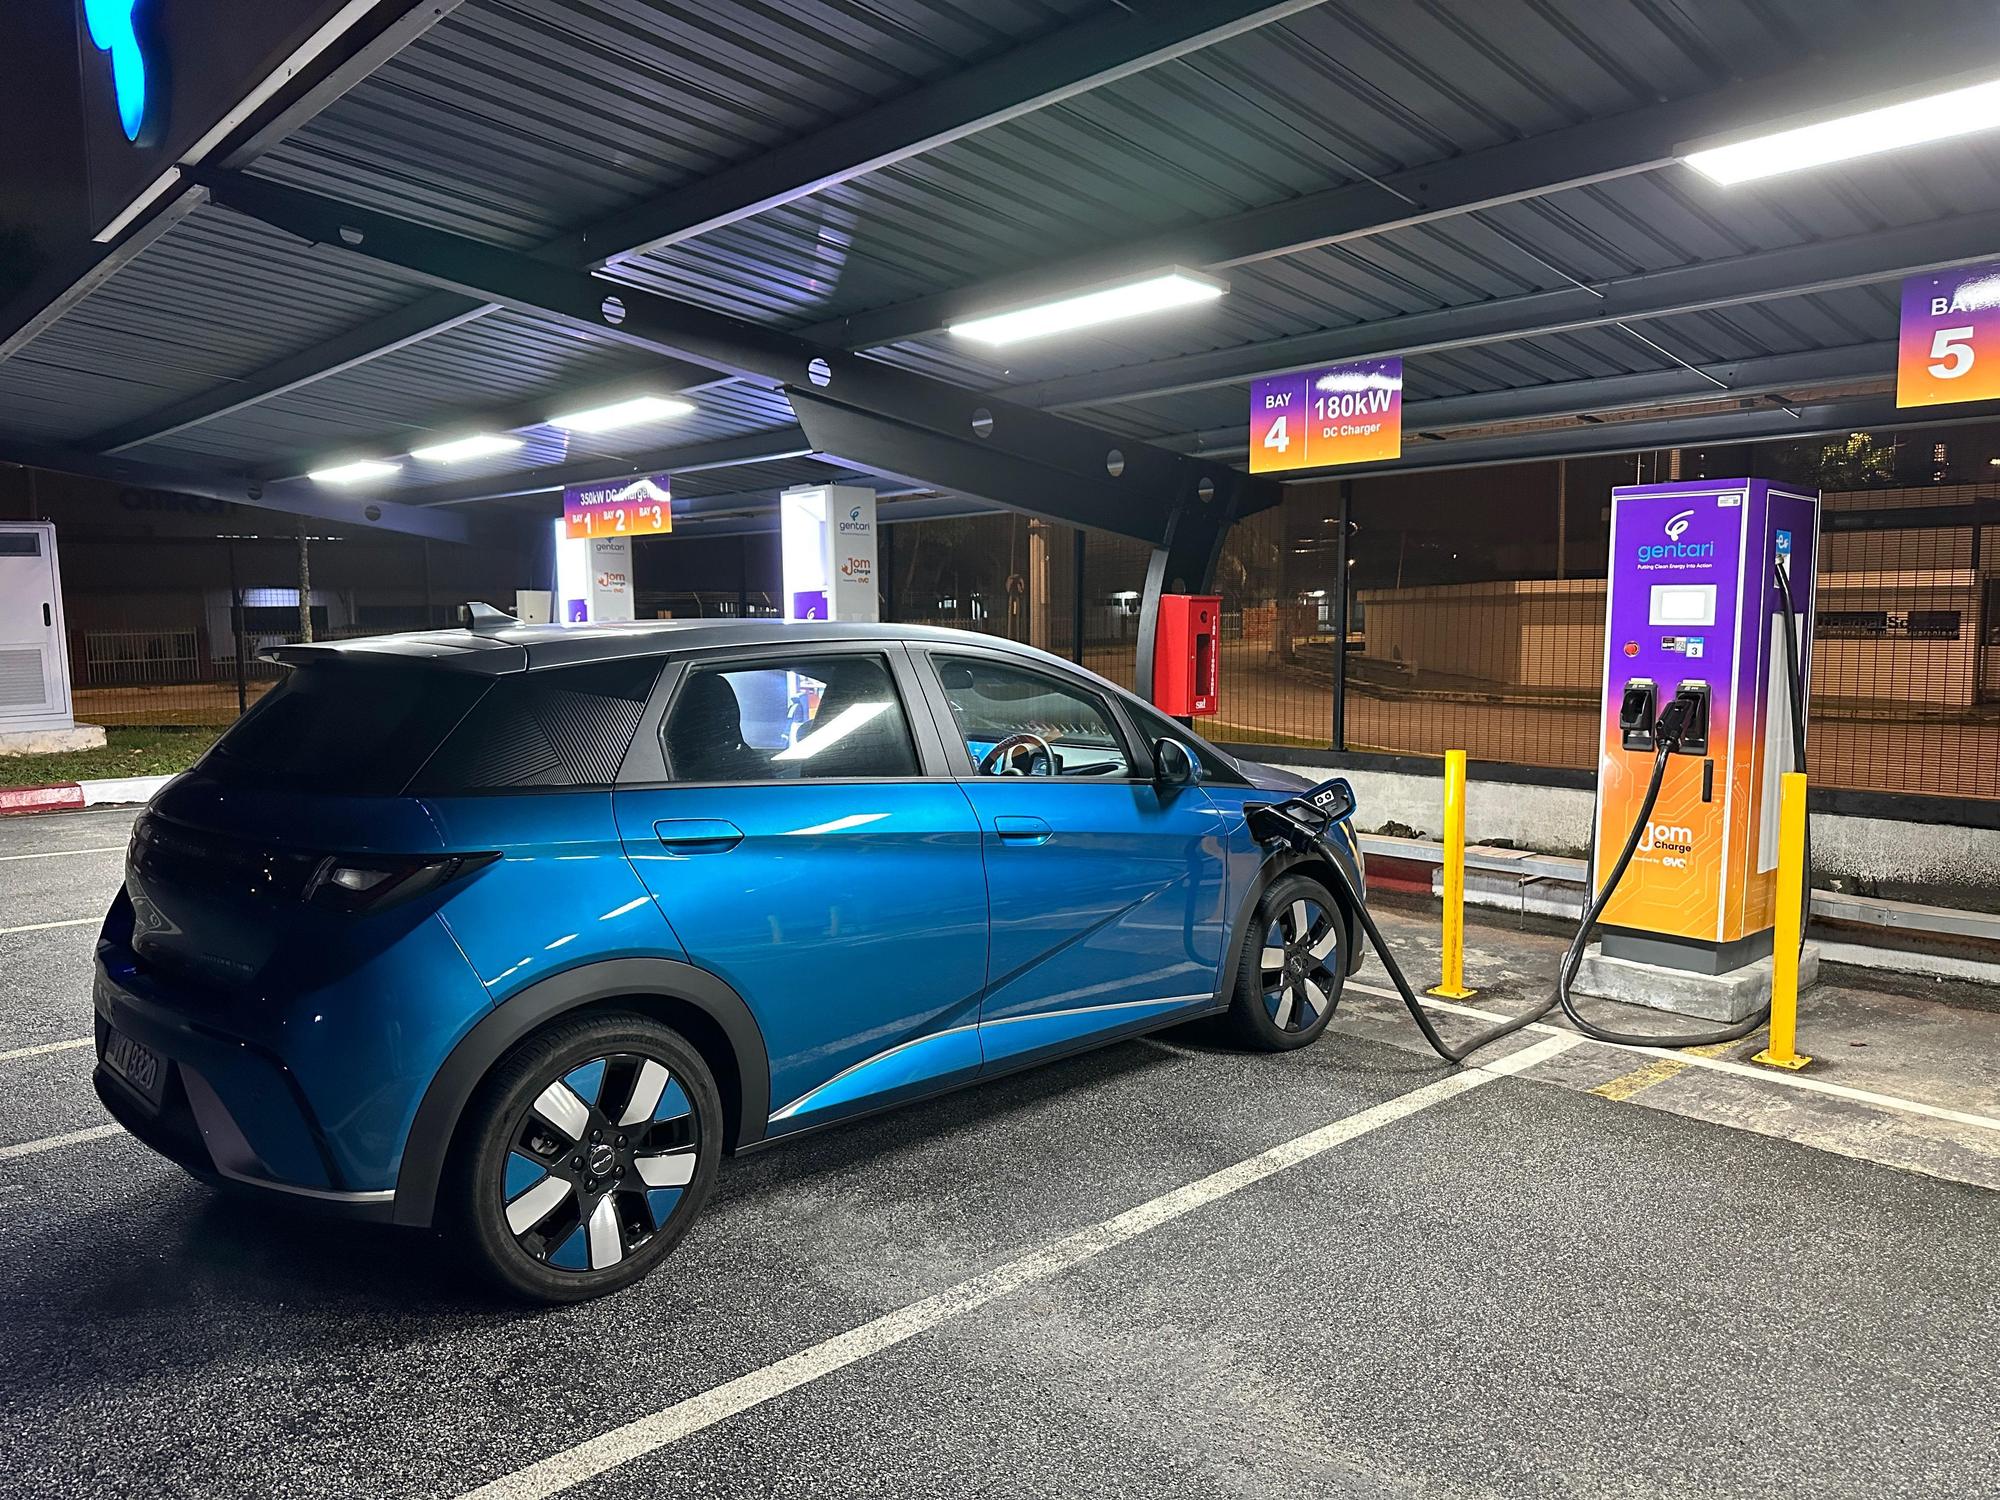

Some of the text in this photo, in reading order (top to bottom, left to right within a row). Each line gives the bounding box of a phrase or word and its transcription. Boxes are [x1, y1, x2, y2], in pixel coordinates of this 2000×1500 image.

[1931, 296, 1981, 316] BA
[1928, 326, 1975, 379] 5
[1265, 392, 1292, 409] BAY
[1314, 388, 1393, 421] 180kW
[1263, 416, 1290, 453] 4
[1323, 422, 1381, 438] DC Charger
[580, 486, 652, 506] 350kW DC Carge
[572, 513, 592, 534] BAY 1
[603, 509, 625, 531] BAY 2
[639, 506, 661, 528] BAY 3
[840, 521, 870, 531] gentari
[1638, 541, 1714, 562] gentari
[1691, 647, 1698, 656] 3
[1654, 841, 1692, 853] Charge
